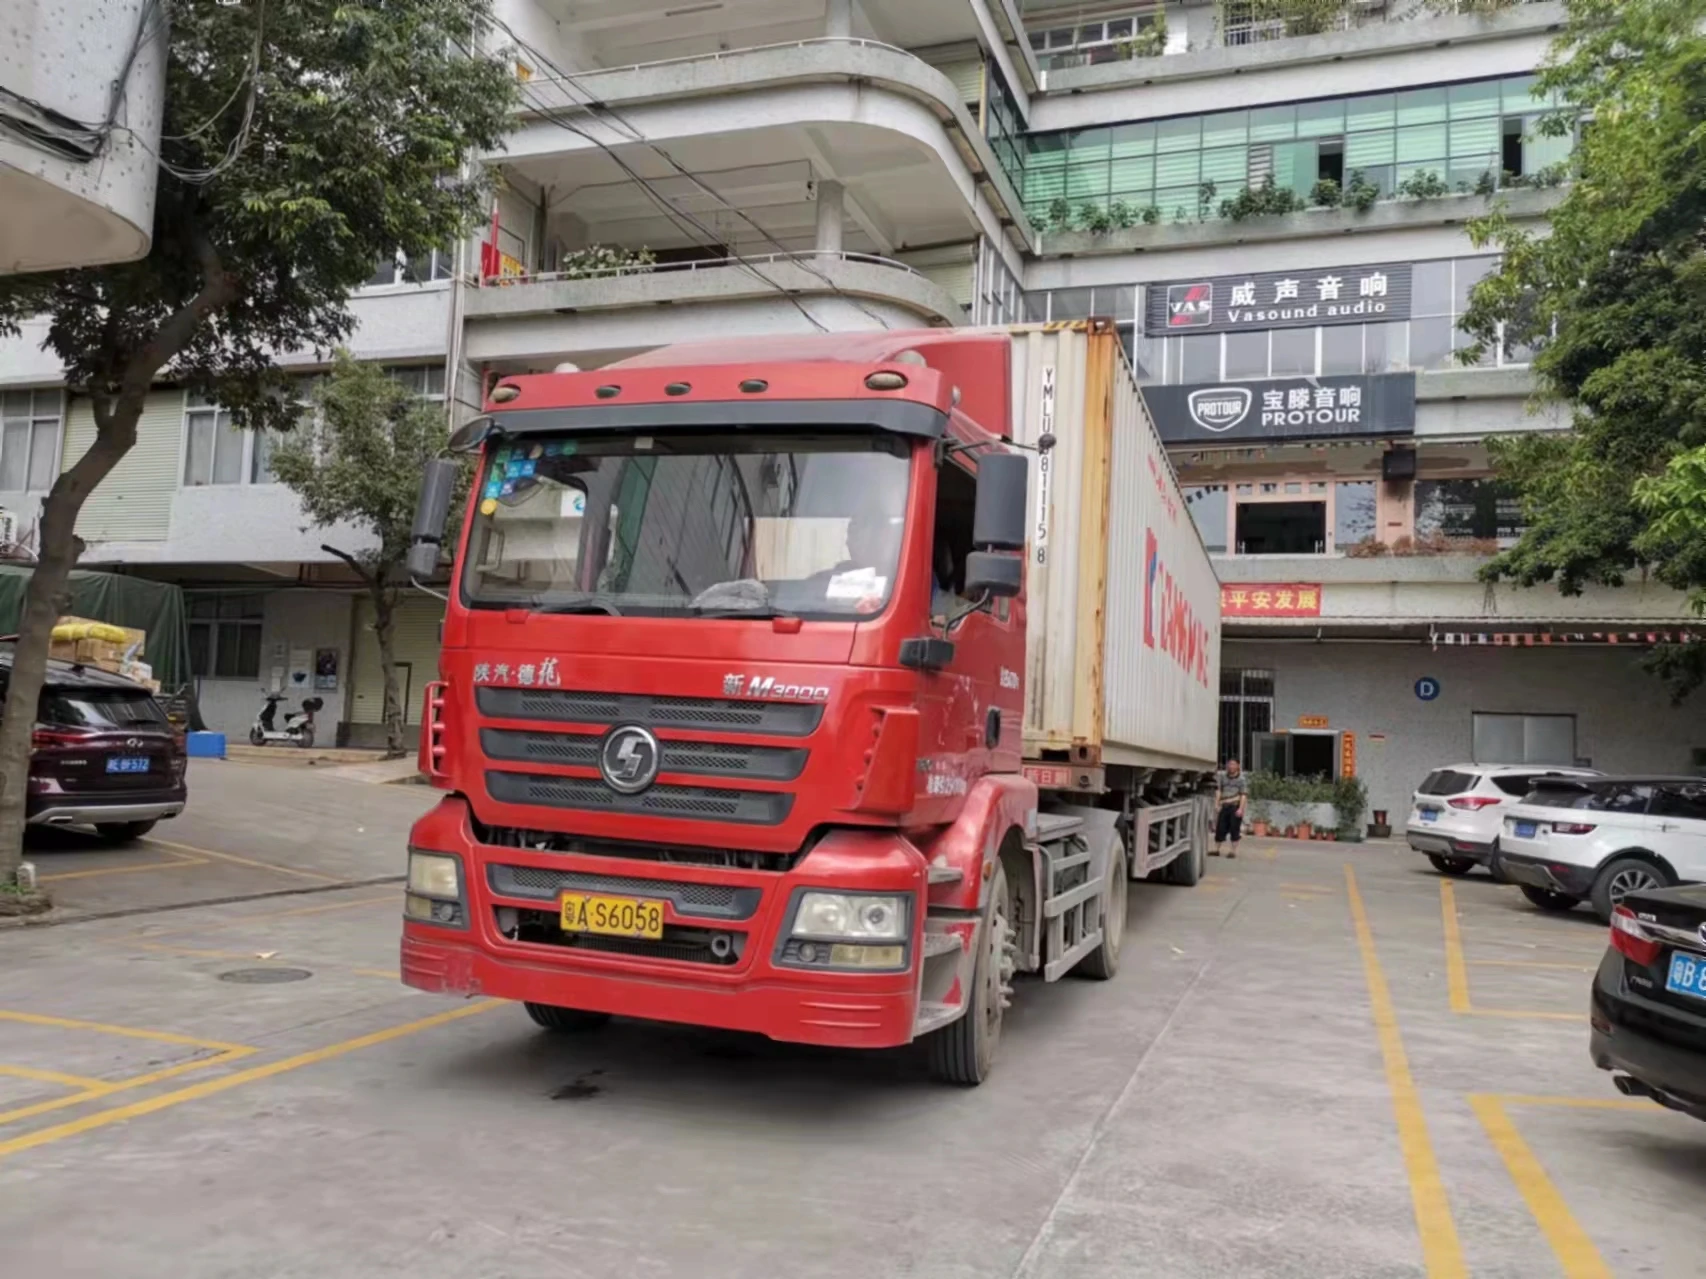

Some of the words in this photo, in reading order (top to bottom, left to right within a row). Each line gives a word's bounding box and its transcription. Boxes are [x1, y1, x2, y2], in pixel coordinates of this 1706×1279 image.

[1229, 272, 1388, 306] 威声音响
[1228, 306, 1318, 322] Vasound
[1327, 300, 1386, 316] audio
[1197, 400, 1242, 415] PROTOUR
[1262, 408, 1360, 426] PROTOUR
[1221, 589, 1318, 610] 平安发展
[1420, 681, 1435, 697] D
